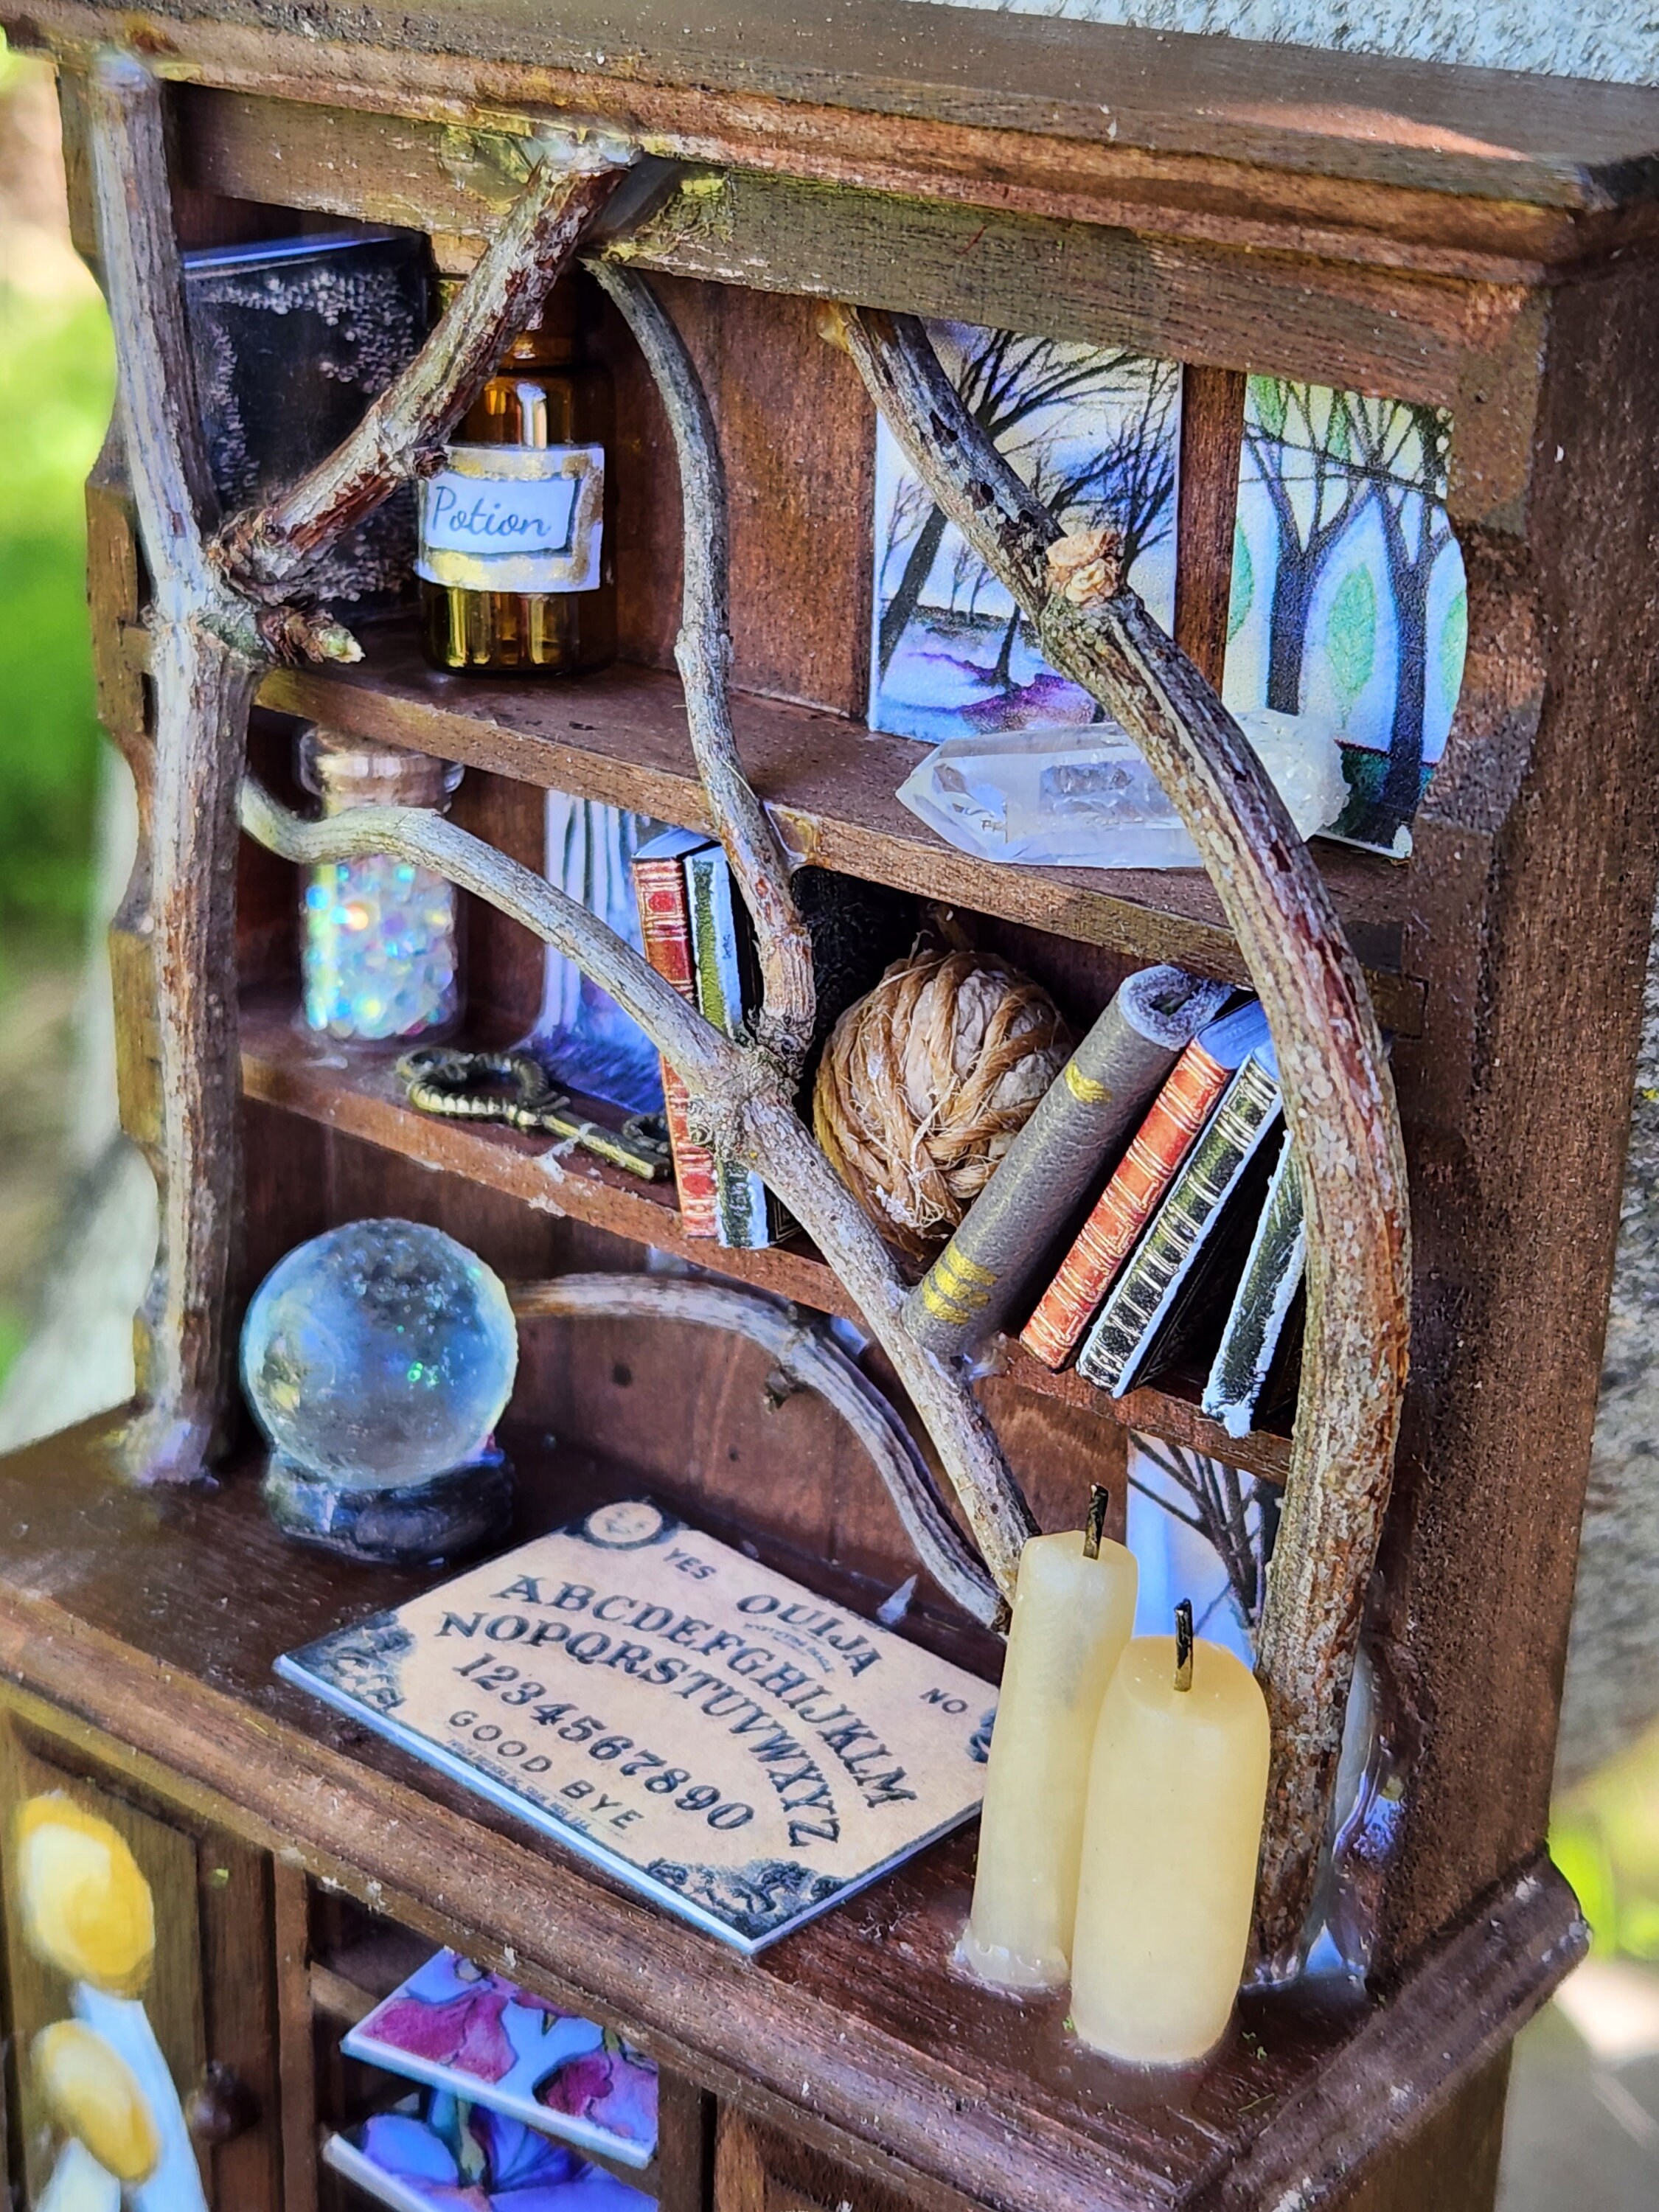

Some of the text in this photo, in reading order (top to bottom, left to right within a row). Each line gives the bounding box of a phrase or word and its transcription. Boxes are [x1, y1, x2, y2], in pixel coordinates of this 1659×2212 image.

[431, 485, 552, 537] Potion
[664, 1548, 717, 1580] YES
[737, 1594, 883, 1677] OUIJA
[435, 1611, 840, 1848] NOPQRSTUVWXYZ
[453, 1652, 756, 1832] 1234567890
[490, 1574, 917, 1809] ABCDEFGHIJKLM
[919, 1687, 969, 1715] NO
[448, 1710, 553, 1773] GOOD
[560, 1779, 644, 1830] BYE
